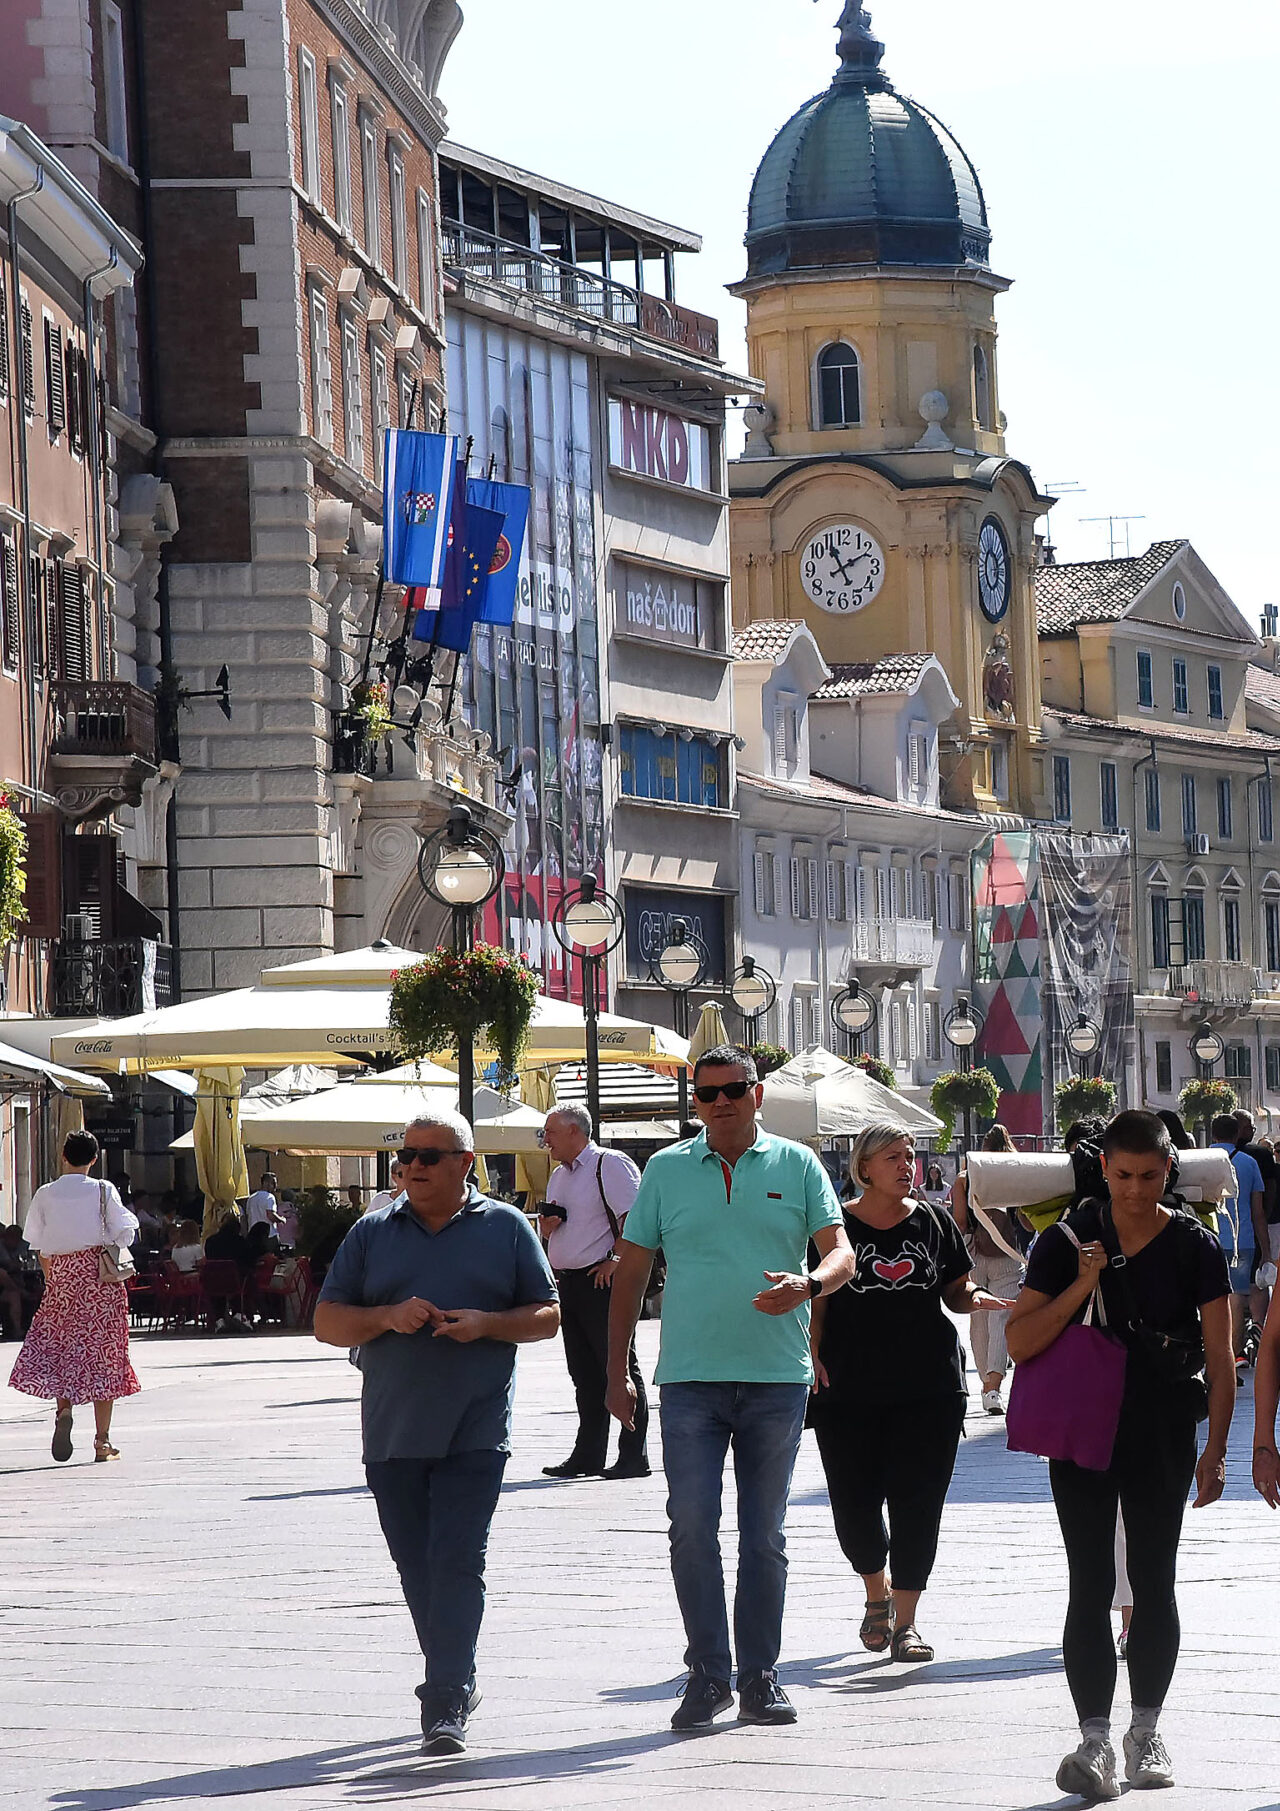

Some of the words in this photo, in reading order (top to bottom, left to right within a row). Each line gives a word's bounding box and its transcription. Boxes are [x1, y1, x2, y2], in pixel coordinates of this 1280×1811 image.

[621, 397, 688, 484] NKD
[823, 533, 834, 550] 11
[836, 528, 851, 546] 12
[855, 532, 861, 549] 1
[809, 542, 824, 559] 10
[863, 541, 873, 557] 2
[805, 561, 816, 578] 9
[870, 558, 880, 576] 3
[811, 578, 823, 596] 8
[862, 576, 875, 592] 4
[627, 583, 653, 626] naš
[825, 590, 836, 607] 7
[837, 592, 849, 610] 6
[852, 588, 863, 606] 5
[510, 639, 561, 671] TRADCIJU
[326, 1033, 385, 1044] Cocktail's
[383, 1133, 398, 1142] ICE
